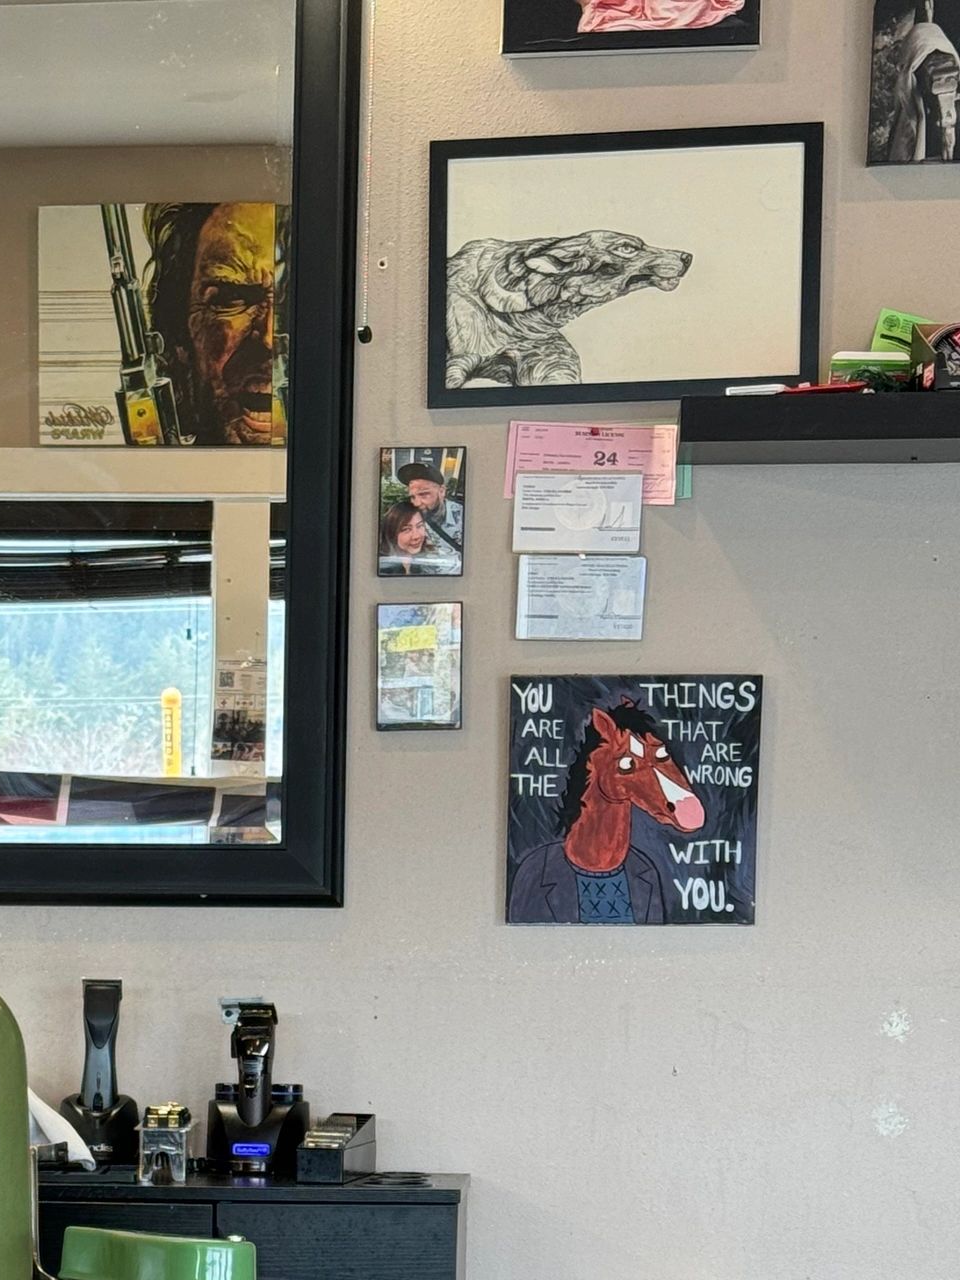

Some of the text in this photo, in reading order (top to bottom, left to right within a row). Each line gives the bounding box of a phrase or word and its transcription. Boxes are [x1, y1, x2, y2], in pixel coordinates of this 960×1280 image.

[592, 450, 619, 467] 24
[512, 682, 553, 714] YOU
[639, 681, 757, 712] THINGS
[521, 718, 564, 740] ARE
[661, 719, 724, 742] THAT
[524, 746, 568, 768] ALL
[700, 742, 742, 763] ARE
[510, 773, 559, 798] THE
[683, 764, 753, 788] WRONG
[668, 839, 742, 865] WITH
[673, 877, 735, 912] YOU.
